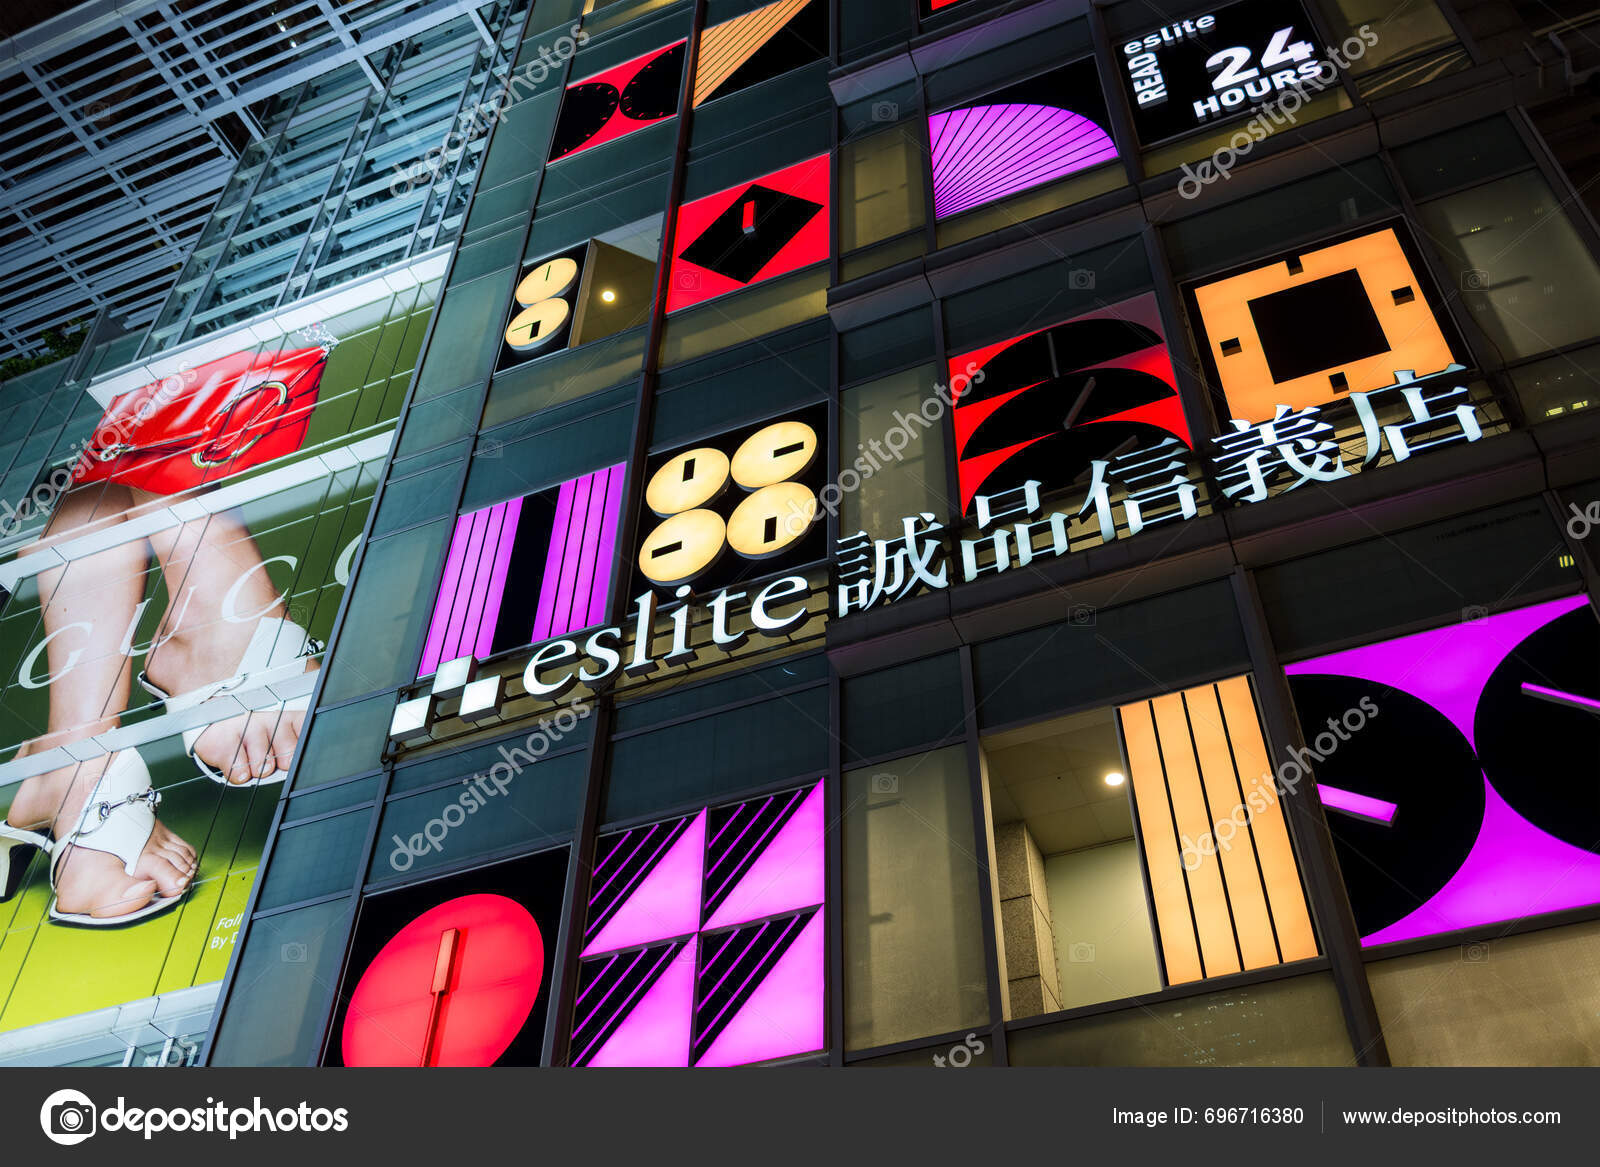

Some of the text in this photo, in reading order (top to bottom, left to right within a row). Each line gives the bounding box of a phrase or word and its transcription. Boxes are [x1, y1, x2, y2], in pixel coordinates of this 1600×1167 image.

[1124, 15, 1216, 54] eslite
[1205, 26, 1315, 90] 24
[1127, 52, 1168, 105] READ
[1193, 59, 1323, 119] HOURS
[835, 363, 1483, 618] 誠品信義店
[523, 575, 808, 696] eslite
[211, 935, 228, 950] By
[216, 912, 244, 930] Fall
